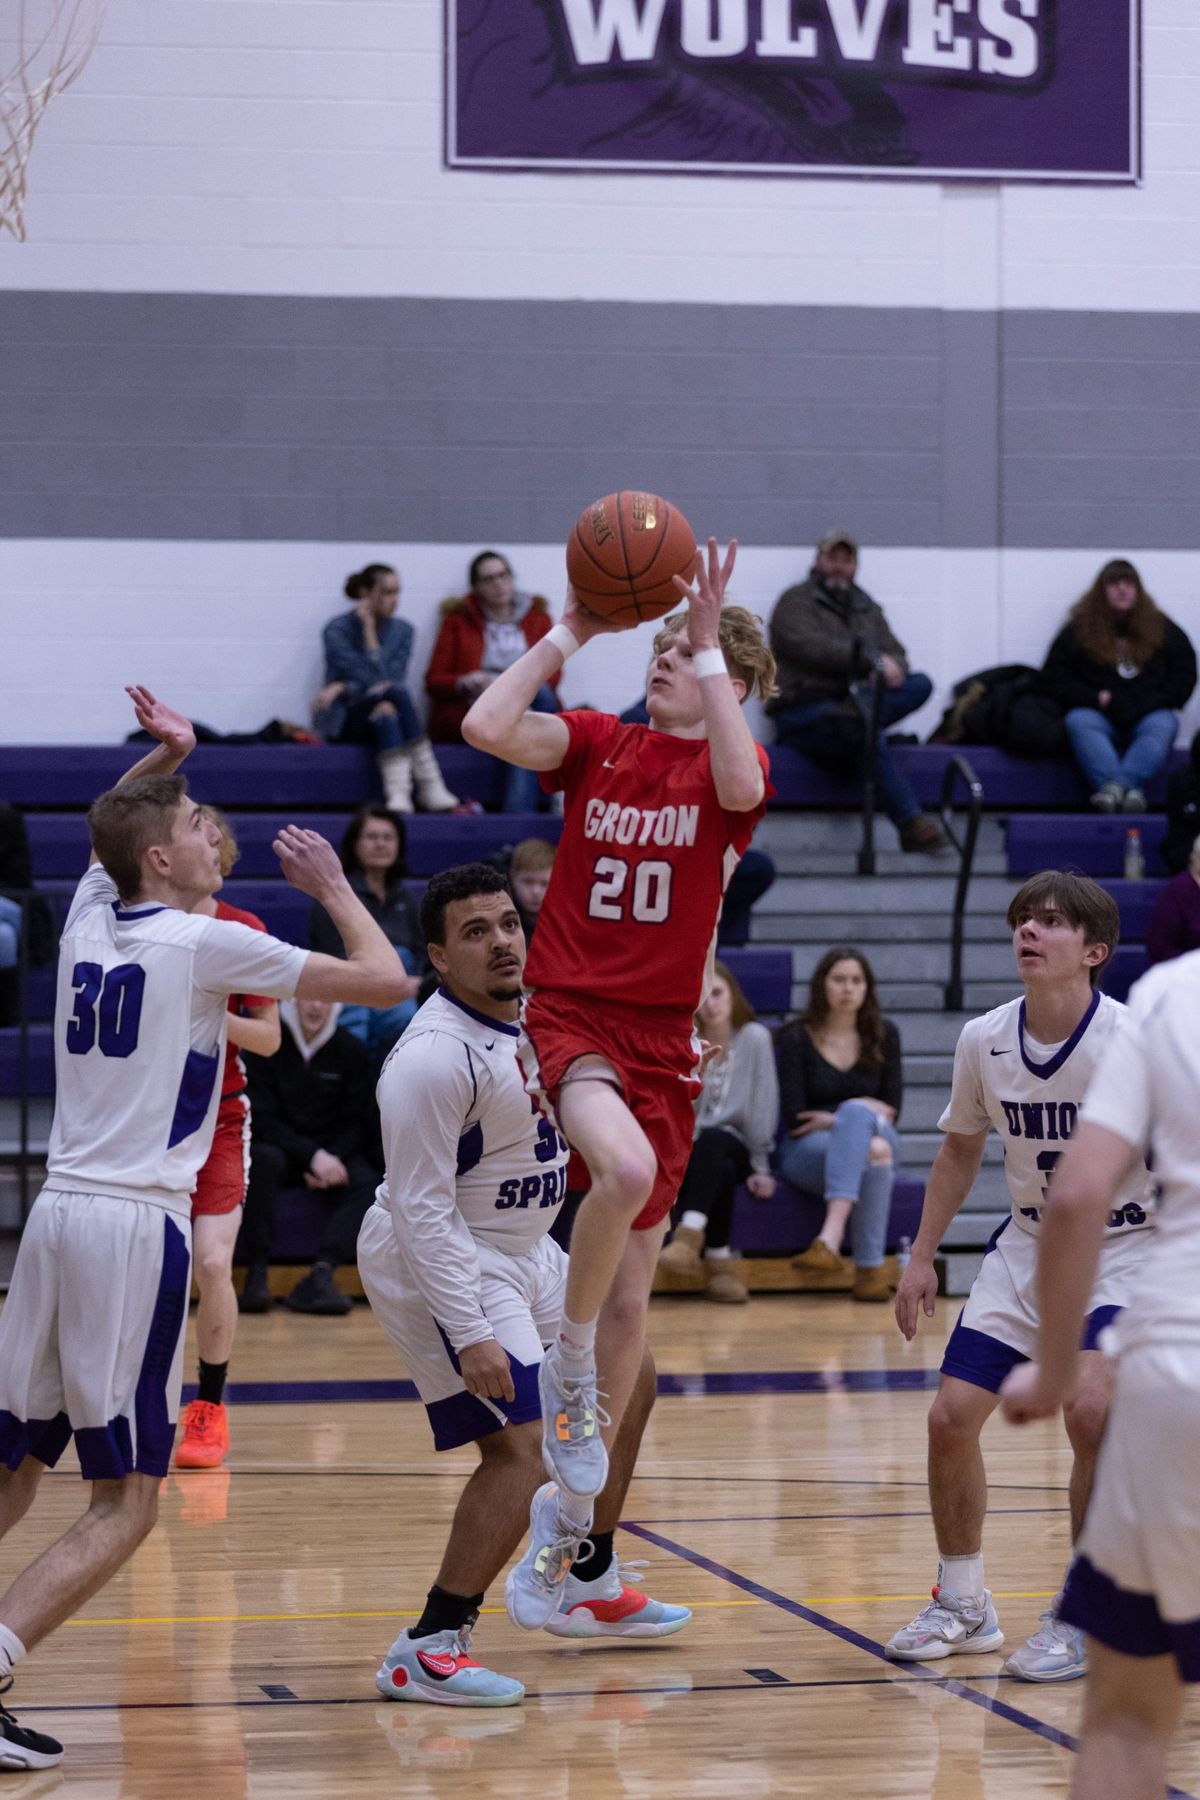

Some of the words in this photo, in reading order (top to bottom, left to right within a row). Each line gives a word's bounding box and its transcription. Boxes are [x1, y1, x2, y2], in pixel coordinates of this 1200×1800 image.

[563, 0, 1039, 78] WOLVES
[584, 798, 700, 847] GROTON
[588, 855, 673, 924] 20
[66, 961, 146, 1058] 30
[1000, 1100, 1083, 1140] UNIO
